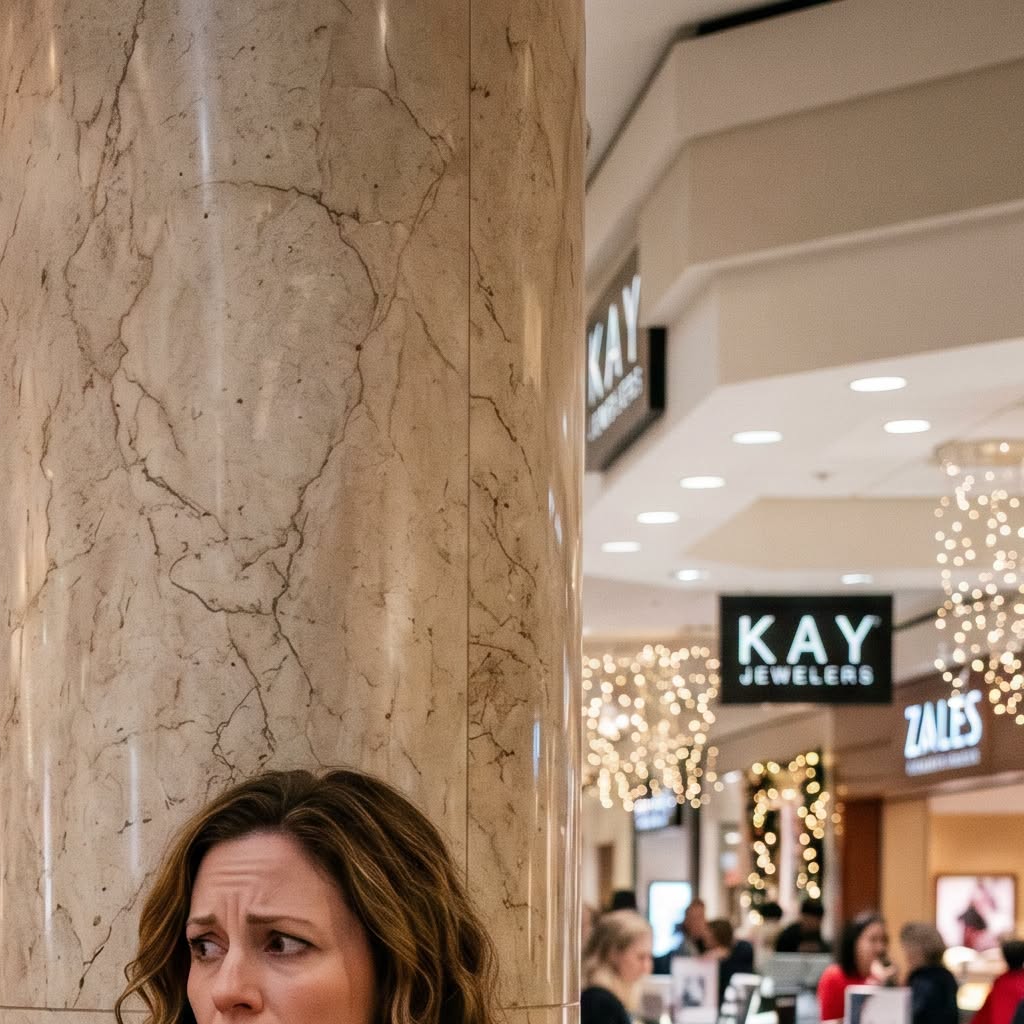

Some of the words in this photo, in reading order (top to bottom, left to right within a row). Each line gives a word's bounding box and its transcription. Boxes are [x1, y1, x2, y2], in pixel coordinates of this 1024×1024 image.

[589, 274, 641, 407] KAY
[738, 614, 876, 665] KAY
[738, 664, 875, 686] JEWELERS
[904, 689, 983, 759] ZALES
